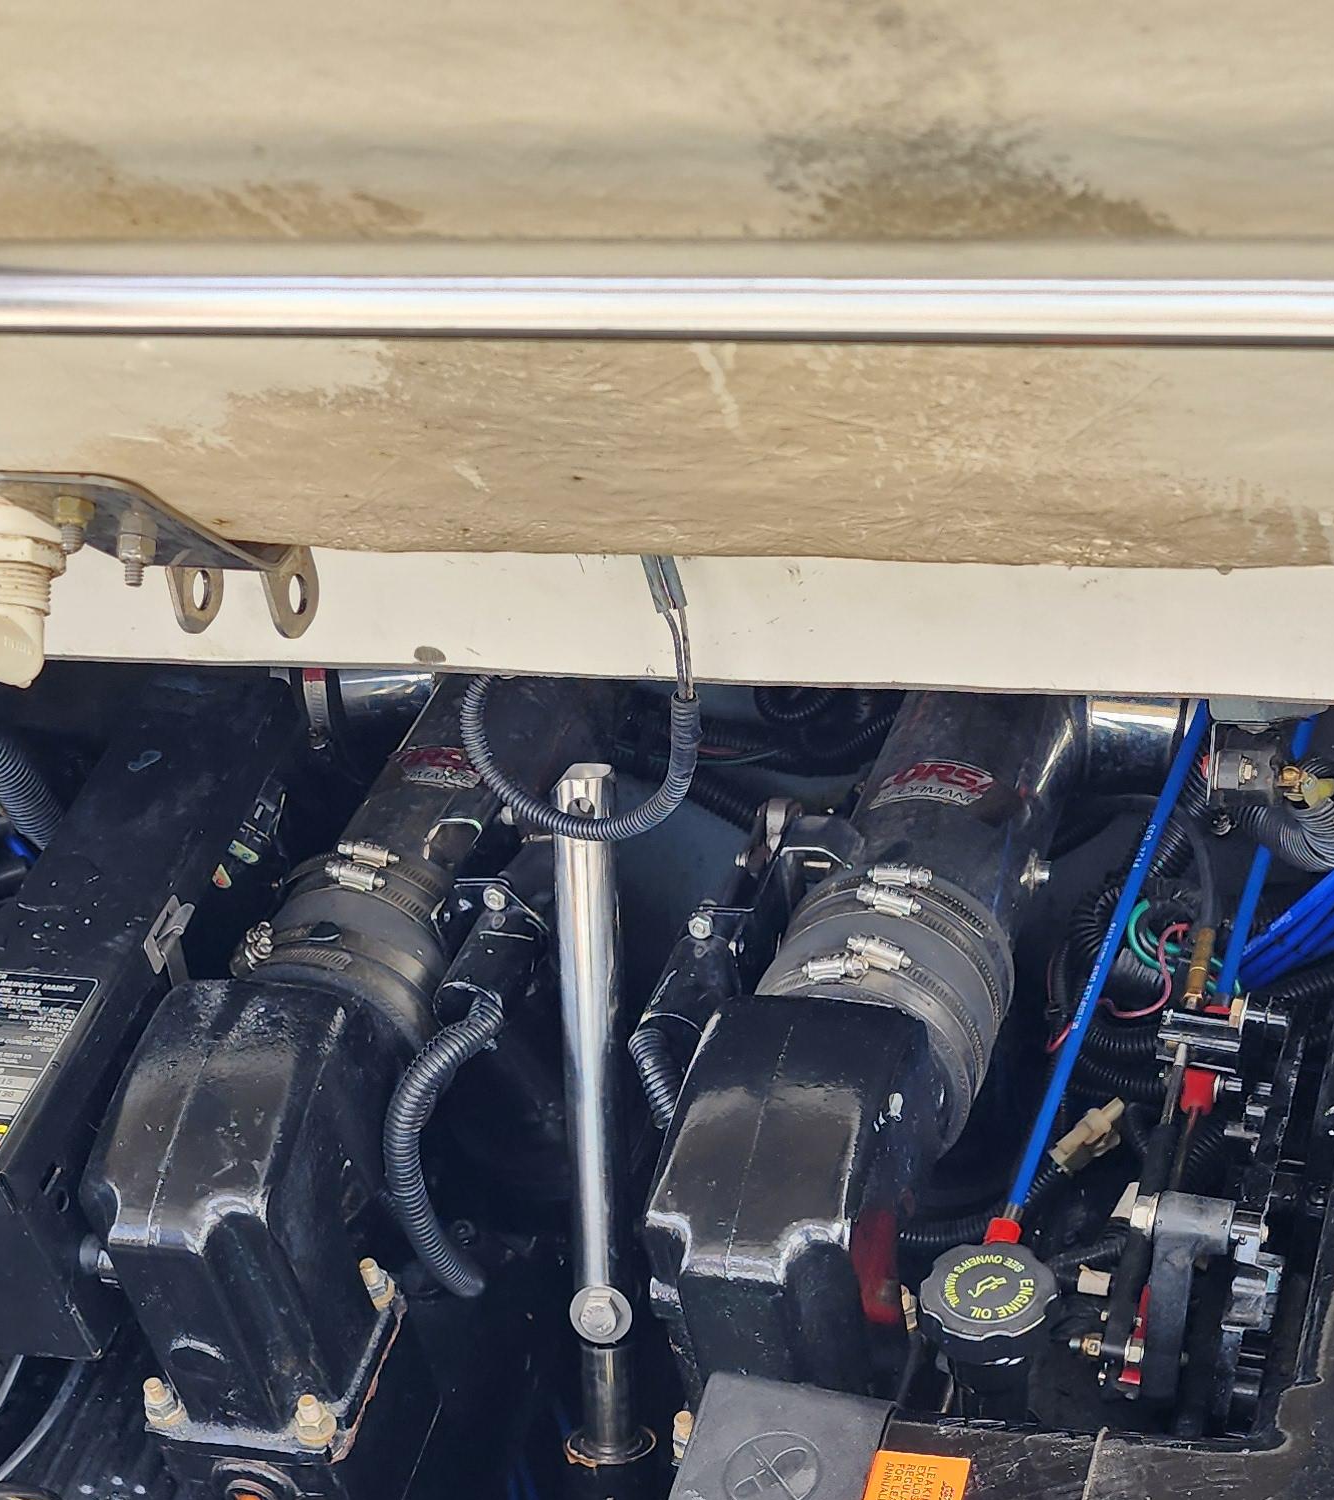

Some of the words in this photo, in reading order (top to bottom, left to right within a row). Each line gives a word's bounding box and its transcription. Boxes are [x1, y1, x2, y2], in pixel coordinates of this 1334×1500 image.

[1003, 1257, 1025, 1273] SEE
[995, 1278, 1034, 1318] ENGINE
[970, 1305, 992, 1319] OIL
[894, 1463, 905, 1481] FOR
